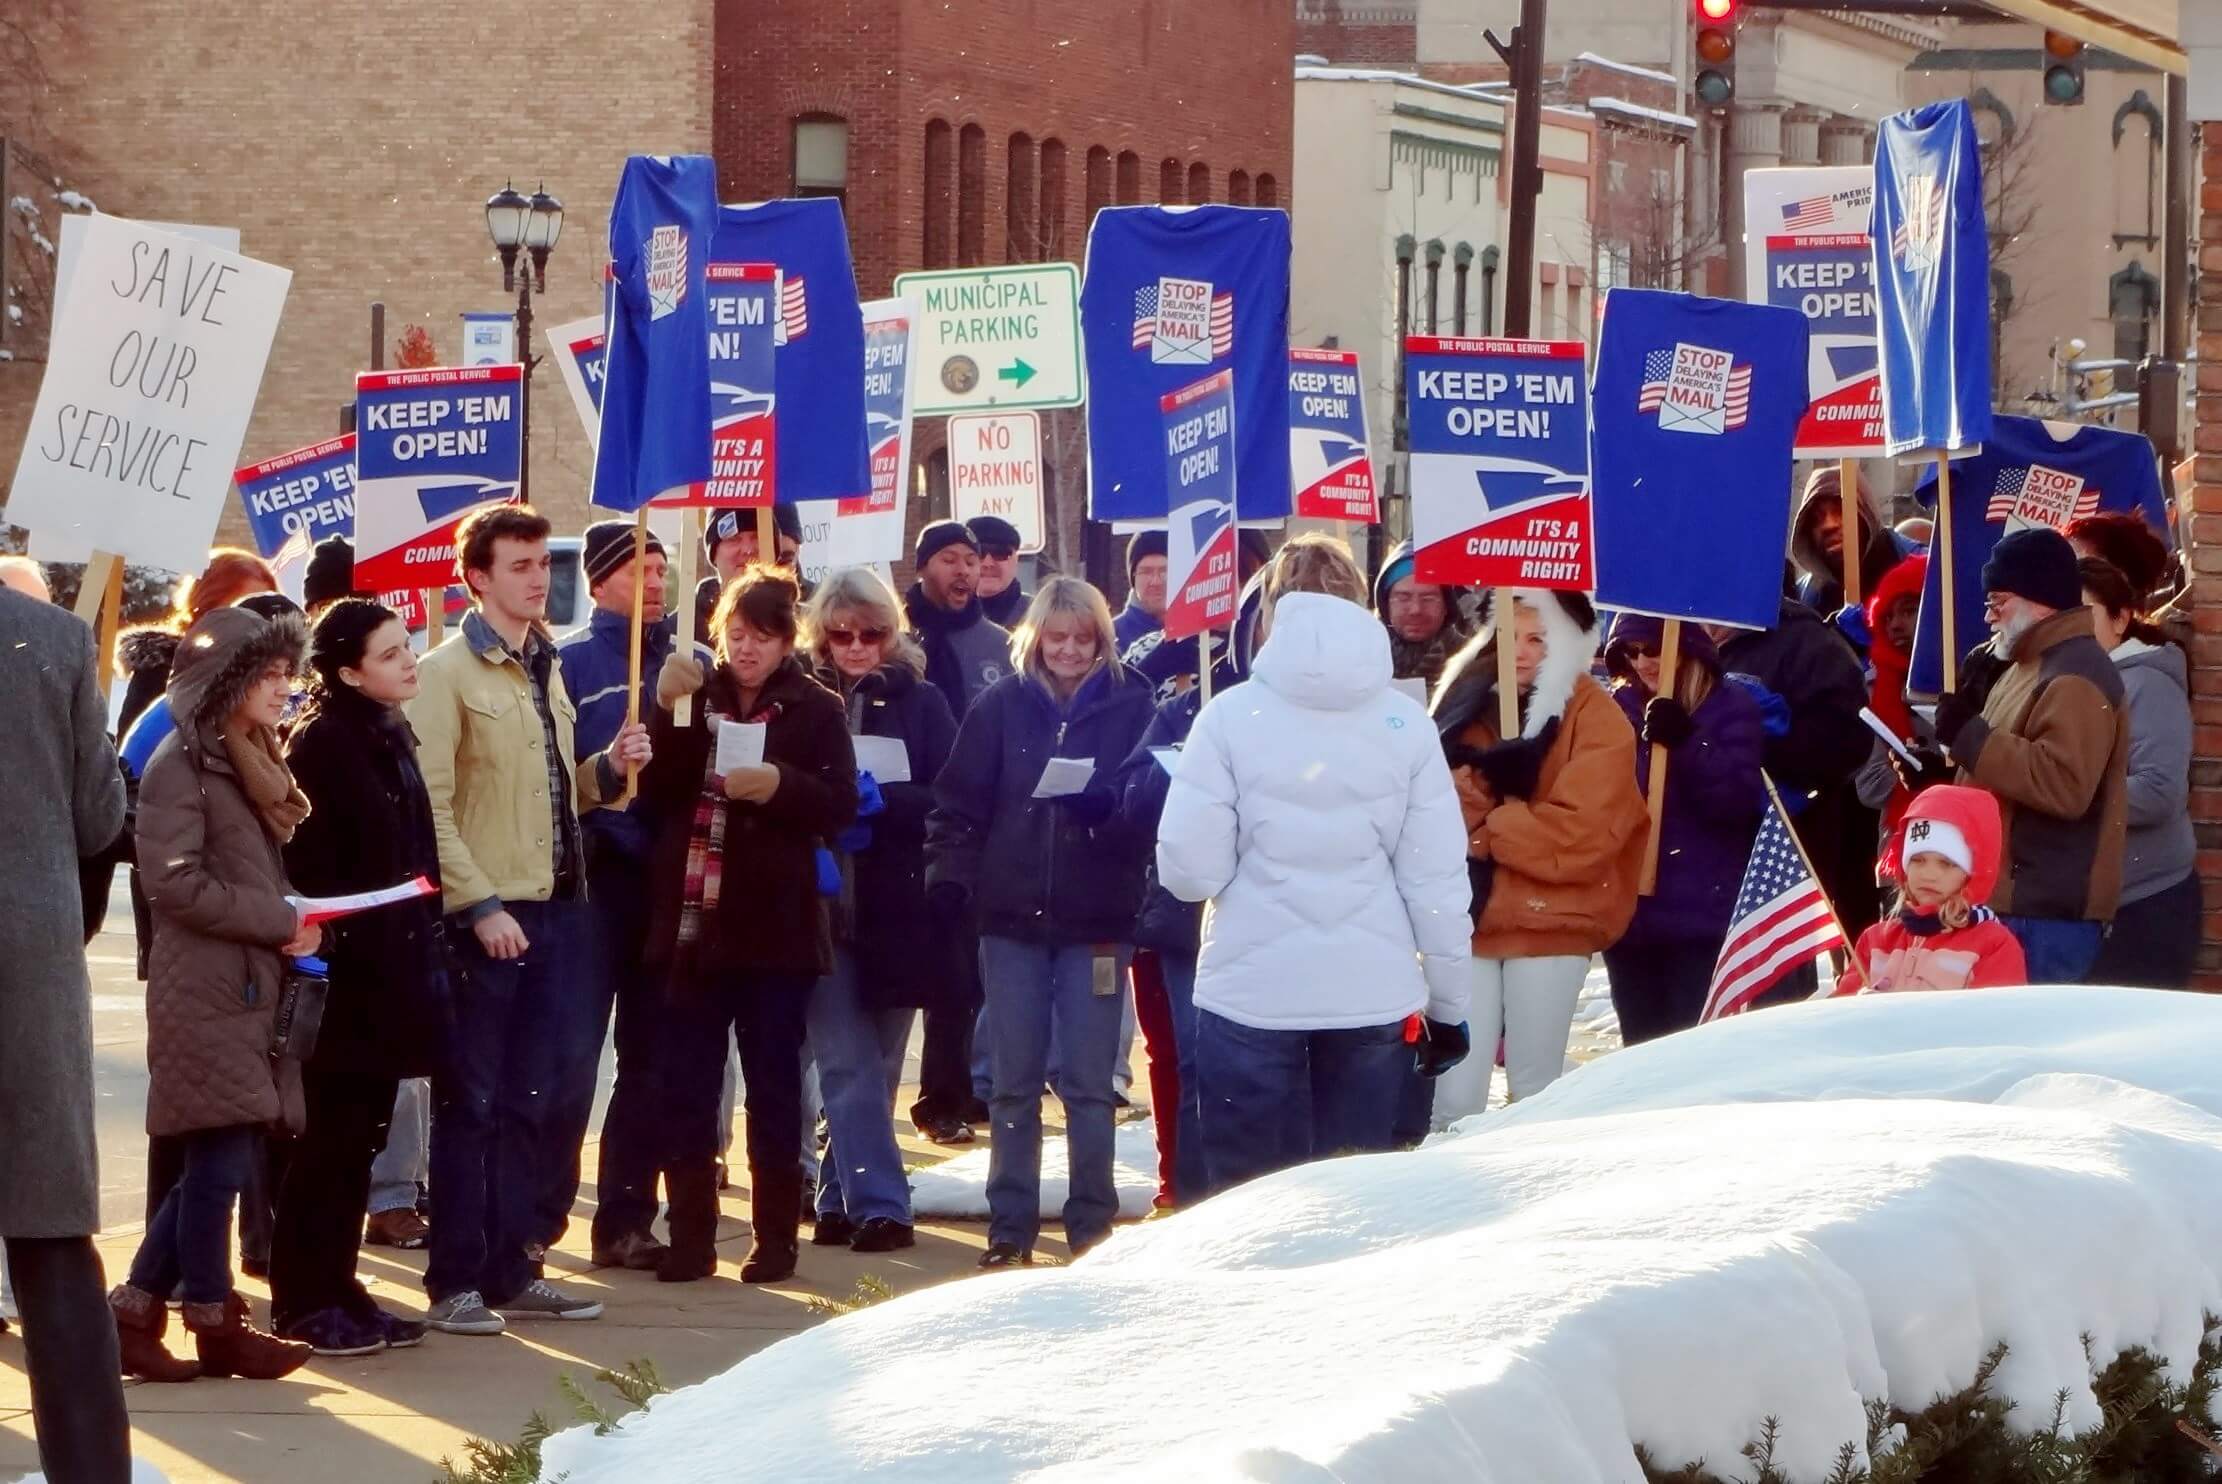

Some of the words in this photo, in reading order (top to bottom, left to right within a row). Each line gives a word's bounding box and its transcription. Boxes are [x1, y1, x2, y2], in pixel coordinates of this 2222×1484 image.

[655, 230, 677, 251] STOP
[1795, 237, 1808, 246] THE
[1809, 236, 1834, 246] PUBLIC
[1836, 235, 1861, 245] POSTAL
[111, 241, 239, 325] SAVE
[712, 267, 745, 277] SERVICE
[1776, 262, 1855, 289] KEEP
[926, 282, 1048, 312] MUNICIPAL
[1163, 282, 1206, 300] STOP
[709, 297, 765, 325] 'EM
[1160, 310, 1206, 321] AMERICA'S
[1161, 299, 1206, 313] DELAYING
[940, 314, 1039, 345] PARKING
[1160, 321, 1203, 340] MAIL
[881, 343, 904, 367] 'EM
[1438, 340, 1454, 350] THE
[1455, 341, 1485, 352] PUBLIC
[1486, 342, 1515, 353] POSTAL
[1517, 343, 1551, 354] SERVICE
[110, 330, 196, 408] OUR
[1678, 348, 1726, 370] STOP
[387, 375, 400, 385] THE
[402, 374, 429, 384] PUBLIC
[431, 371, 458, 382] POSTAL
[459, 369, 490, 380] SERVICE
[1289, 372, 1327, 393] KEEP
[1328, 374, 1357, 395] 'EM
[1672, 376, 1722, 392] AMERICA'S
[1675, 365, 1724, 382] DELAYING
[1418, 370, 1509, 401] KEEP
[1516, 374, 1575, 404] 'EM
[1670, 386, 1718, 410] MAIL
[367, 400, 450, 431] KEEP
[457, 395, 511, 424] 'EM
[1302, 396, 1349, 419] OPEN!
[1168, 417, 1203, 457] KEEP
[1204, 405, 1228, 441] 'EM
[1447, 407, 1550, 439] OPEN!
[393, 429, 487, 461] OPEN!
[713, 439, 746, 456] IT'S
[749, 439, 764, 456] A
[978, 425, 1010, 451] NO
[41, 404, 208, 500] SERVICE
[258, 463, 271, 474] THE
[271, 456, 295, 470] PUBLIC
[293, 448, 317, 463] POSTAL
[316, 441, 343, 455] SERVICE
[958, 460, 1034, 488] PARKING
[1180, 445, 1219, 487] OPEN!
[703, 480, 764, 497] RIGHT!
[1345, 473, 1361, 487] IT'S
[1362, 474, 1369, 488] A
[2030, 469, 2077, 492] STOP
[251, 476, 320, 516] KEEP
[1320, 485, 1371, 502] COMMUNITY
[2026, 484, 2073, 503] DELAYING
[981, 497, 1014, 514] ANY
[1345, 501, 1373, 516] RIGHT!
[2018, 501, 2063, 529] MAIL
[1527, 519, 1562, 538] IT'S
[1565, 521, 1579, 539] A
[1466, 538, 1581, 560] COMMUNITY
[1209, 553, 1224, 575] IT'S
[1225, 551, 1231, 569] A
[1520, 560, 1581, 581] RIGHT!
[1186, 571, 1232, 605] COMMUNITY
[1206, 593, 1232, 618] RIGHT!
